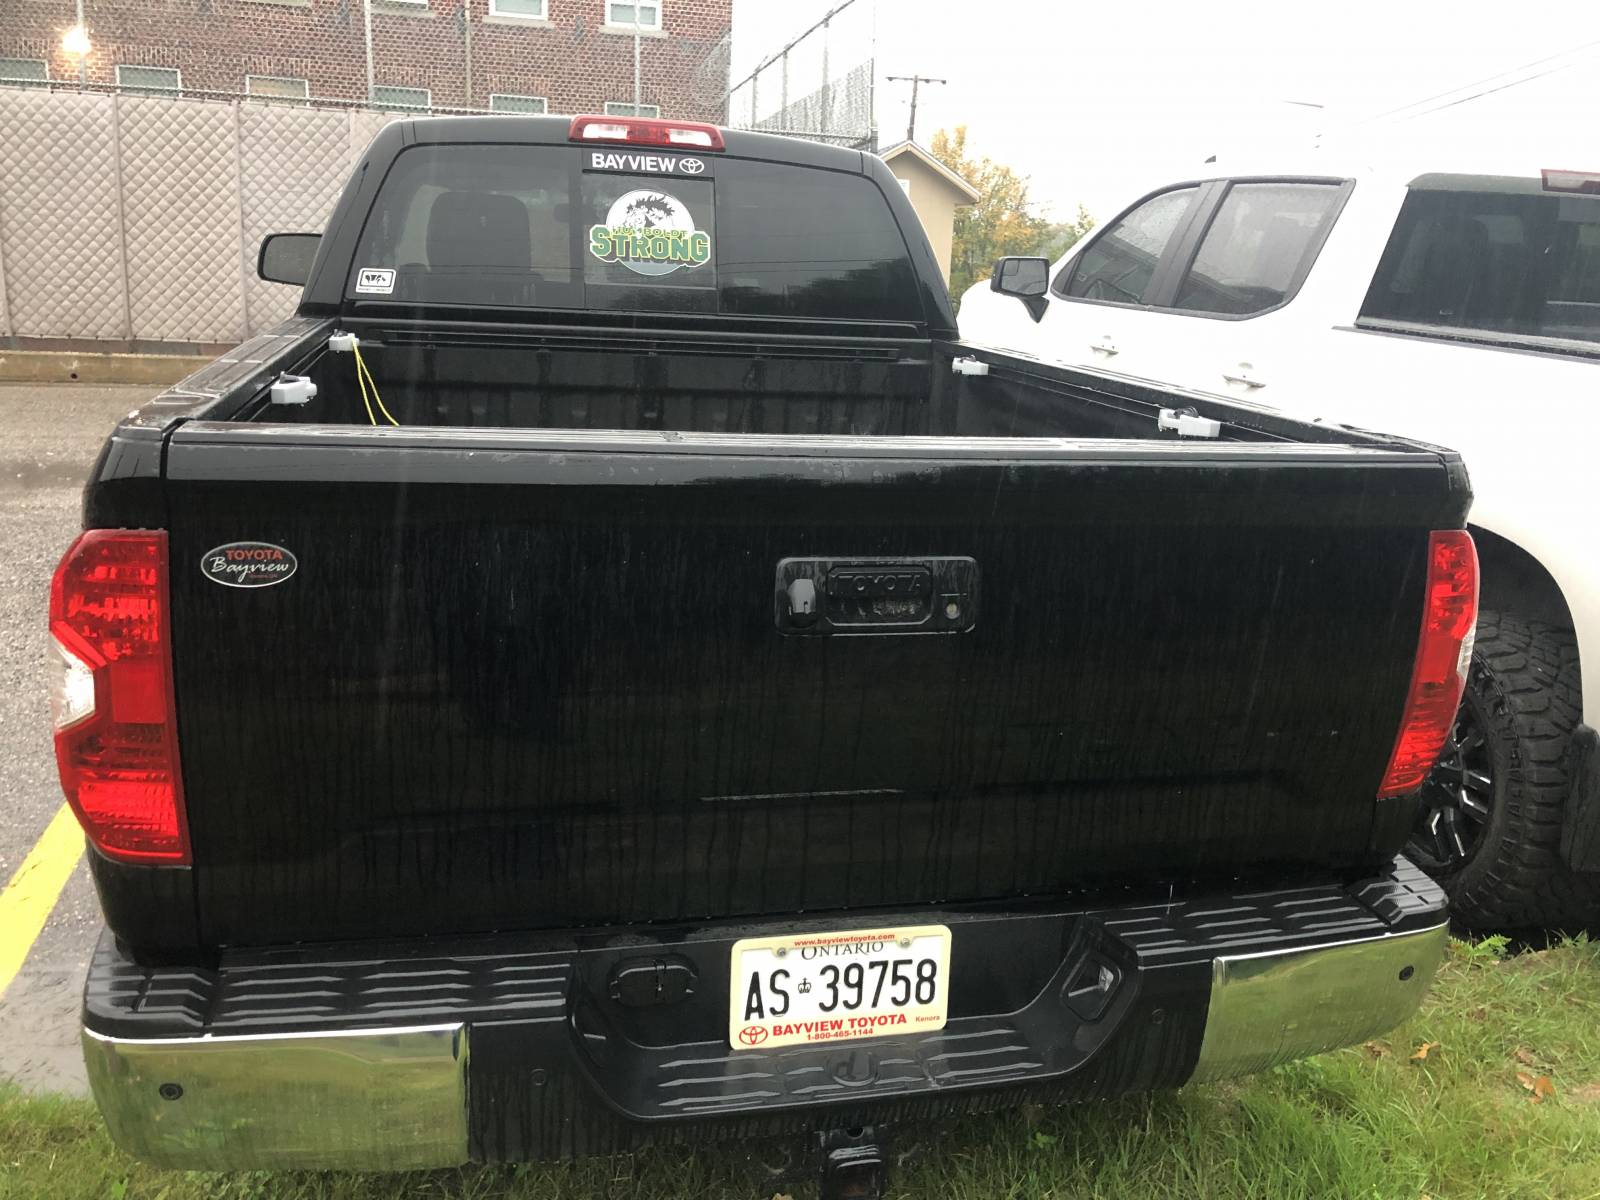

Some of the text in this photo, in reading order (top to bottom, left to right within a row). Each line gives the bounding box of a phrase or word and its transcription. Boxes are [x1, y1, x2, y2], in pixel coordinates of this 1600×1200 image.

[591, 153, 676, 172] BAYVIEW
[591, 225, 709, 264] STRONG
[225, 549, 283, 560] TOYOTA
[210, 556, 289, 583] Bayview
[794, 932, 895, 947] www.bayviewtoyota.com
[802, 940, 884, 960] ONTARIO
[744, 958, 938, 1021] AS 39758
[772, 1013, 907, 1036] BAYVIEW TOYOTA
[916, 1015, 941, 1023] Kenora
[807, 1028, 874, 1040] 1-800-465-1144
